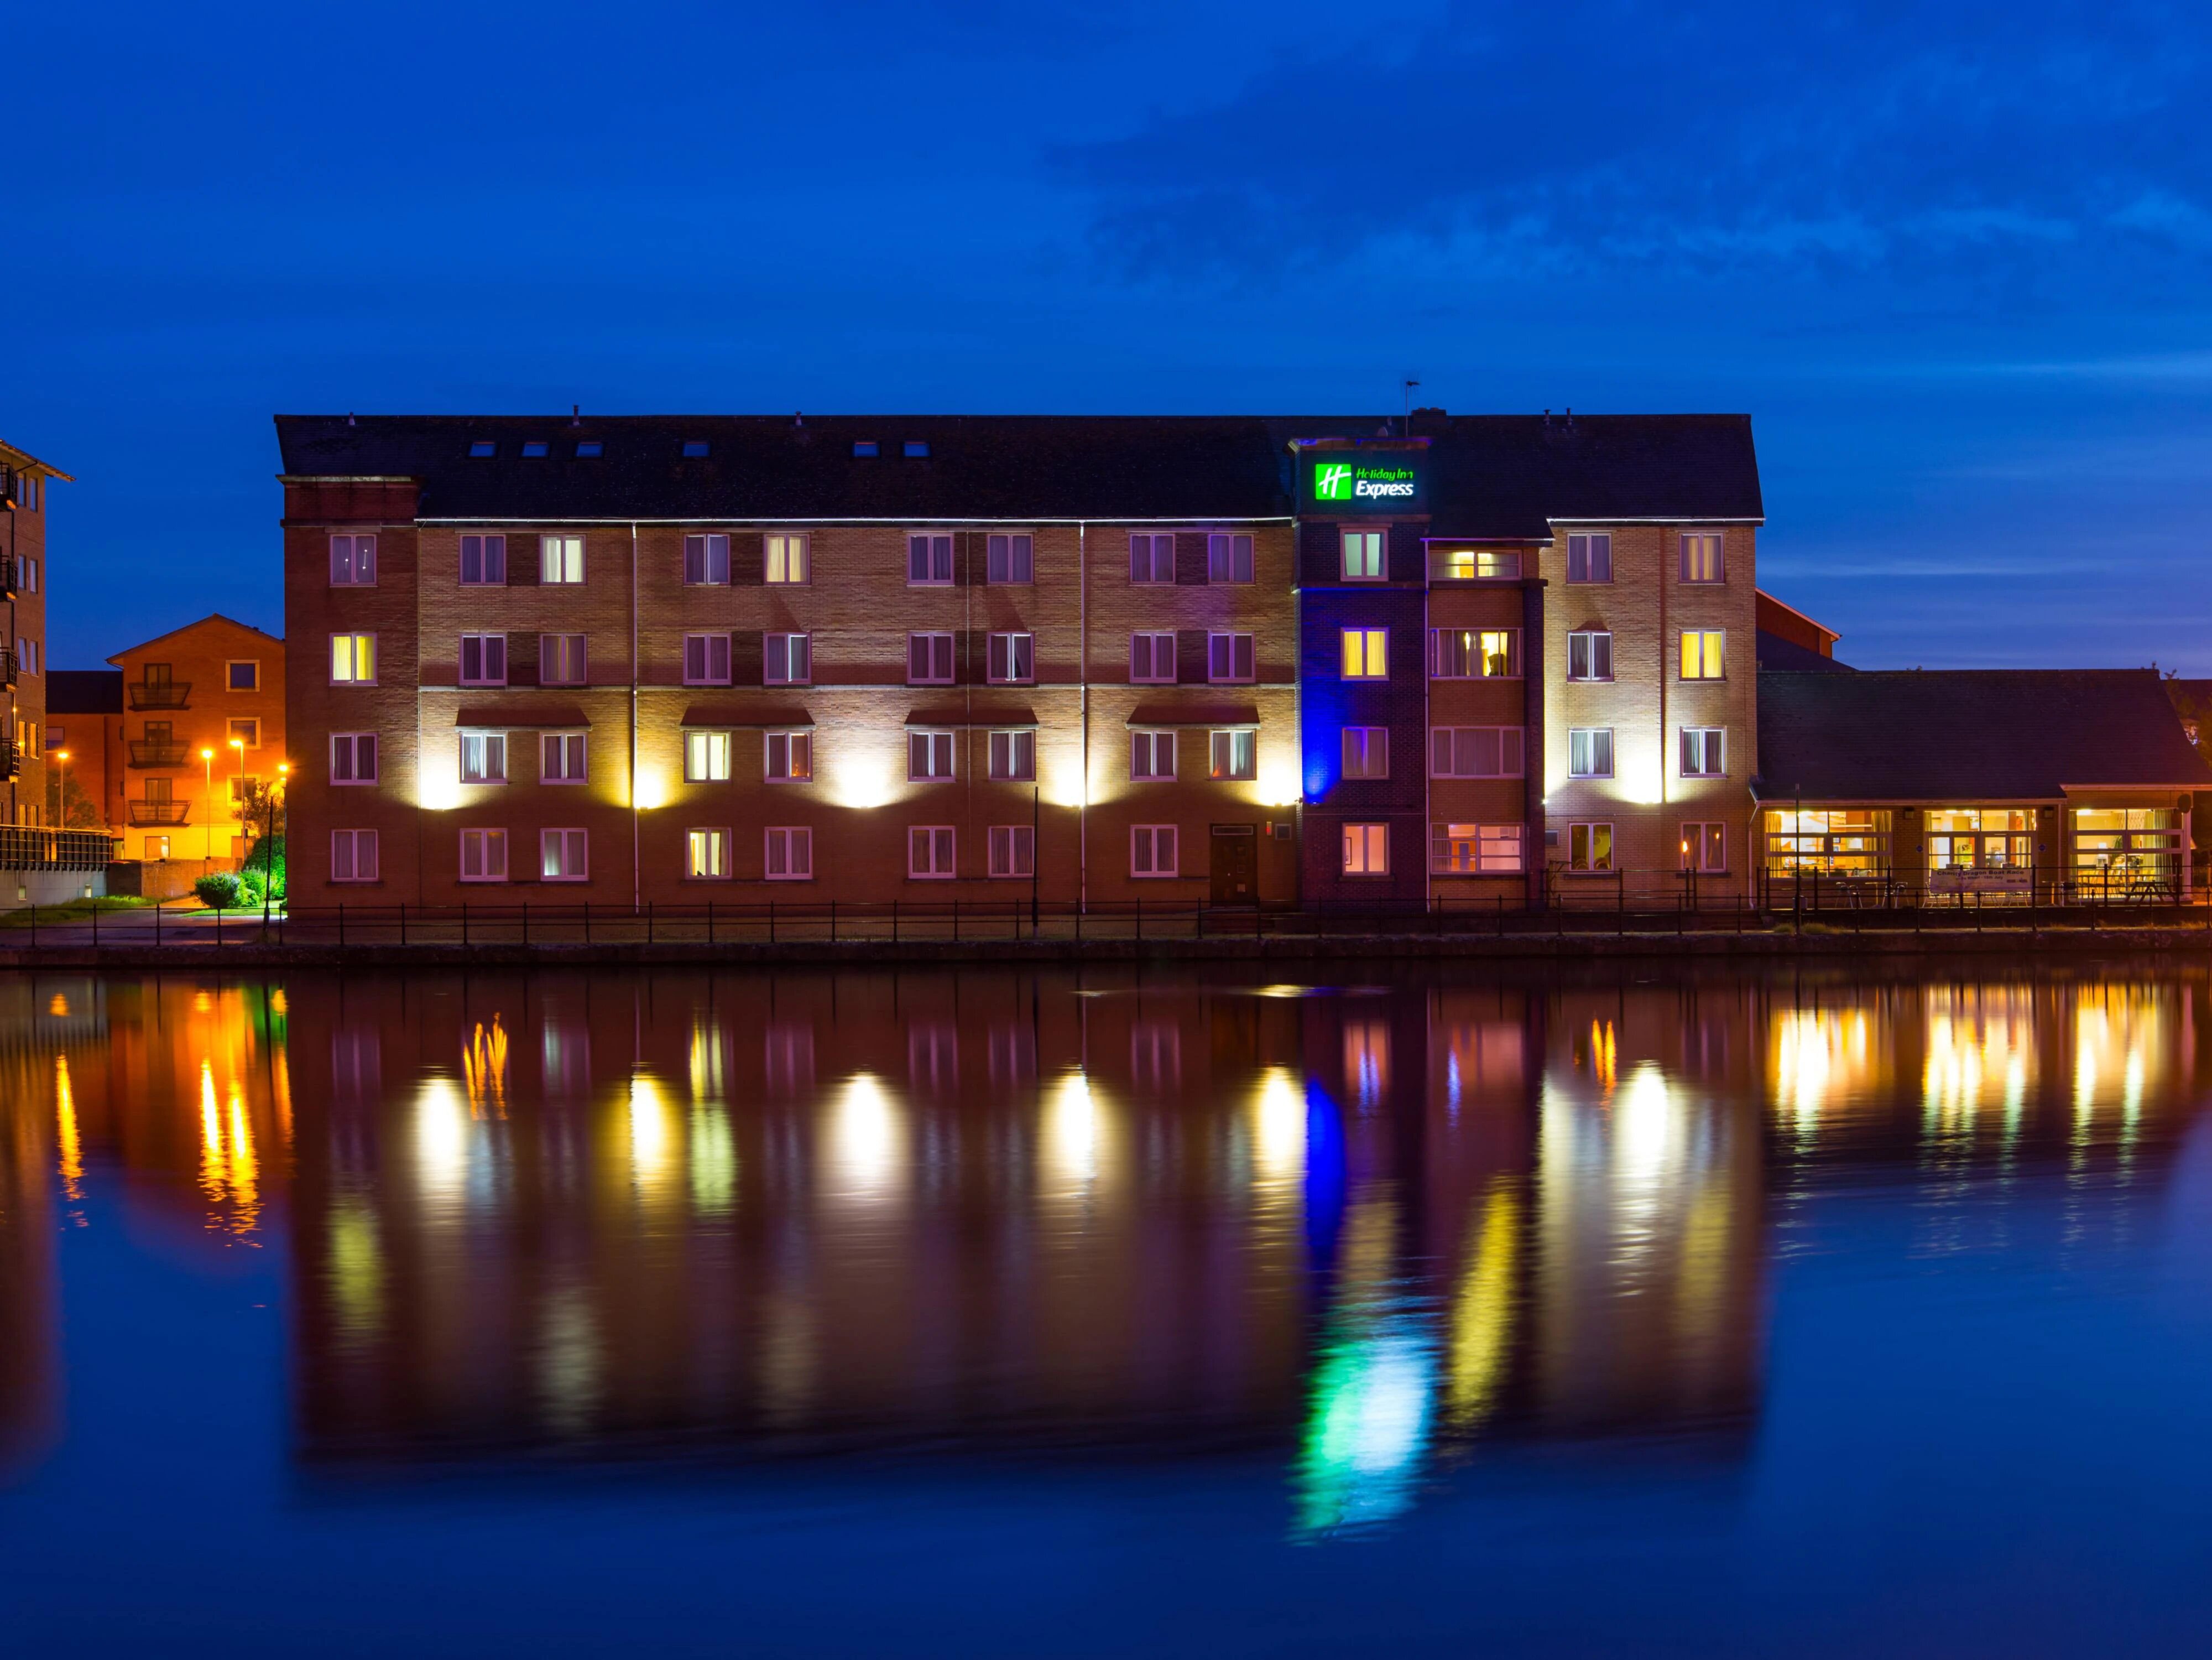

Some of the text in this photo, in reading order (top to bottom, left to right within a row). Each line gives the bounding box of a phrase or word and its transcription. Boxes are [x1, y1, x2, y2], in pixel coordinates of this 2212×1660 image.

[1357, 468, 1413, 481] Holiday Inn
[1356, 480, 1413, 499] Express
